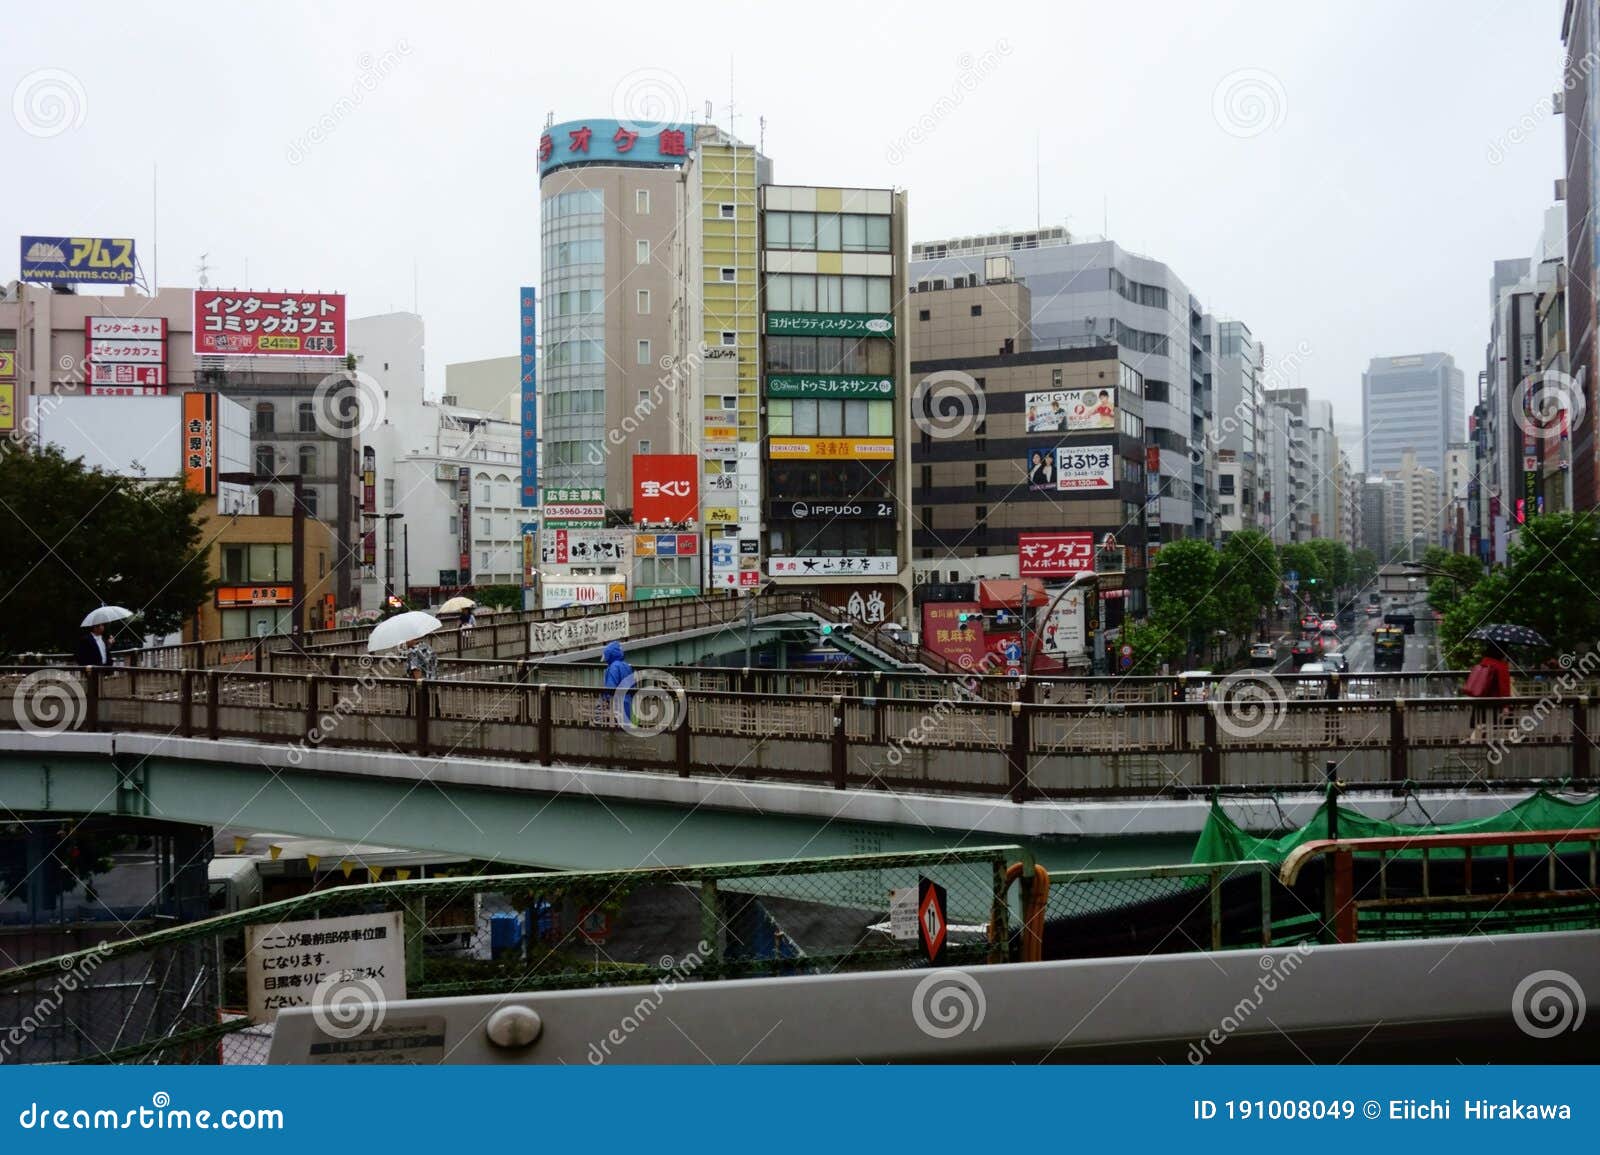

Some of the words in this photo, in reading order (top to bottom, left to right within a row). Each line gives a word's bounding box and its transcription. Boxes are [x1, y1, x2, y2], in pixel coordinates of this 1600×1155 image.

[70, 239, 132, 268] アムス
[23, 269, 133, 281] www.amms.co.jp
[205, 296, 336, 316] インターネット
[94, 324, 158, 334] インターネット
[205, 315, 335, 334] コミックカフェ
[94, 346, 159, 356] コミックカフェ
[801, 380, 879, 392] ドゥミルネサンス
[1053, 392, 1080, 401] GYM
[189, 419, 203, 468] 吉野家
[1060, 454, 1110, 469] はるやま
[641, 481, 690, 497] 宝くじ
[547, 490, 602, 501] 広告主募集
[546, 506, 603, 515] 03-5960-2633
[811, 506, 862, 514] IPPUDO
[877, 504, 893, 515] 2F
[1021, 542, 1091, 557] ギンダコ
[776, 562, 796, 571] 焼肉
[1023, 558, 1089, 567] ハイボール横丁
[263, 926, 387, 949] ここが最前部停車位置
